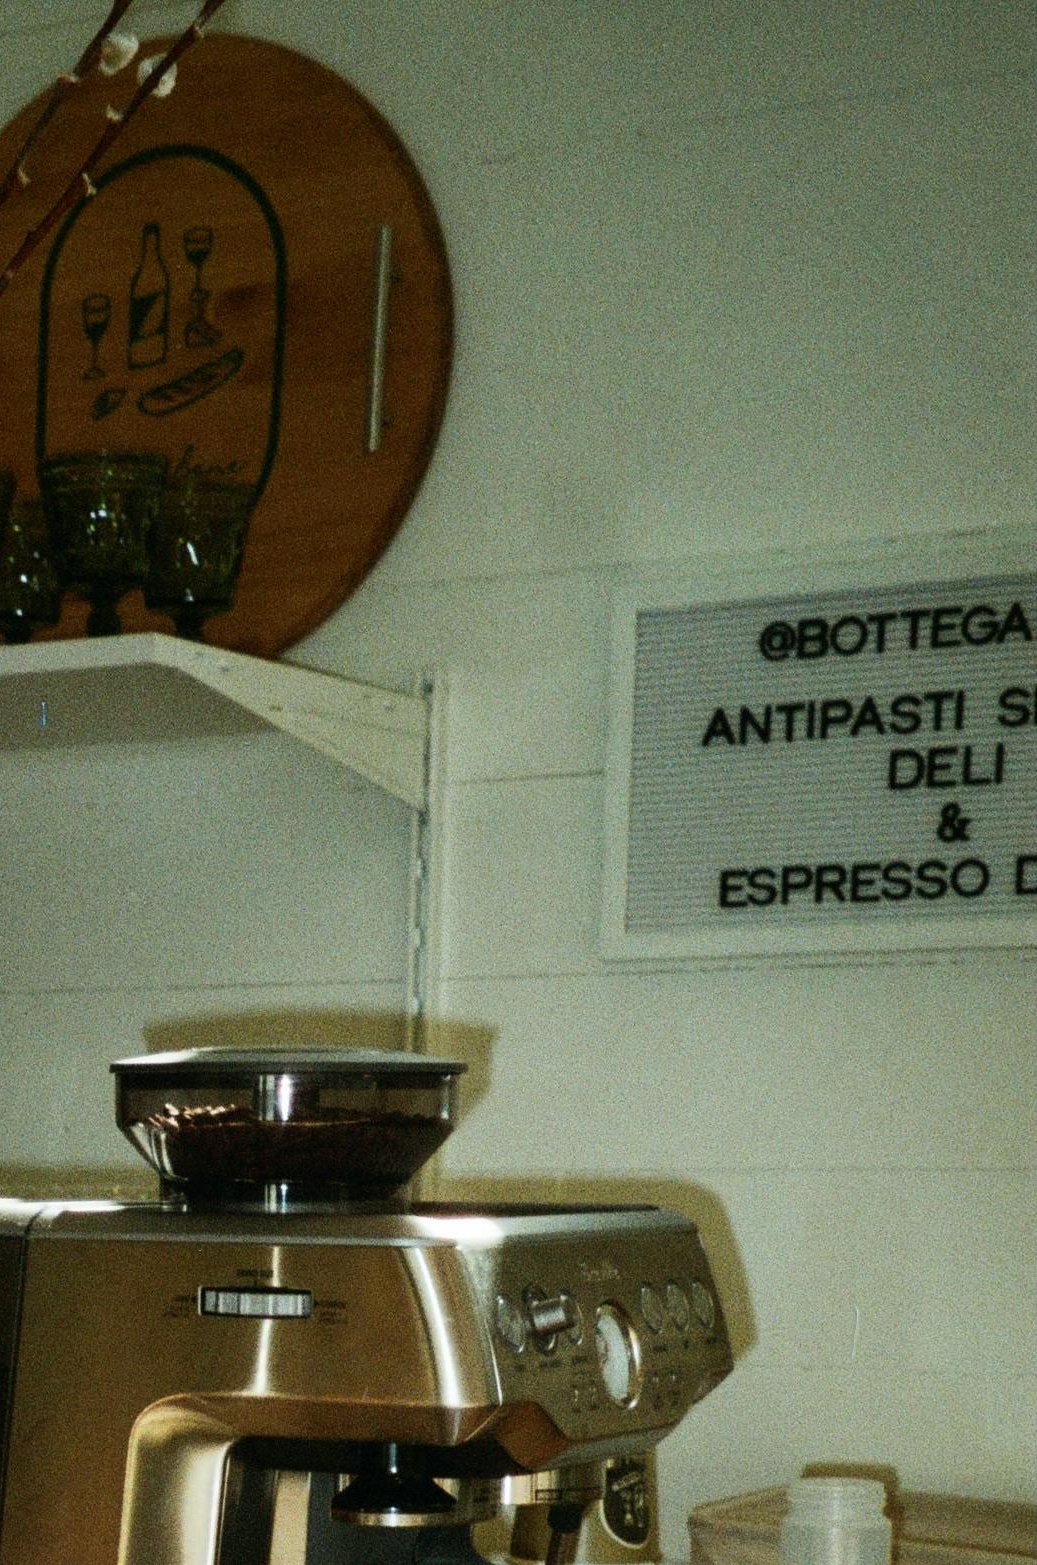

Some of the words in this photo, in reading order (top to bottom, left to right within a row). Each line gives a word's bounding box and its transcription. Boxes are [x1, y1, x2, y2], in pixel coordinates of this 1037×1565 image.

[759, 602, 1032, 662] @BOTTEGA
[702, 691, 965, 747] ANTIPASTI
[998, 685, 1037, 727] S
[888, 743, 1005, 790] DELI
[937, 803, 970, 843] &
[719, 858, 990, 909] ESPRESSO
